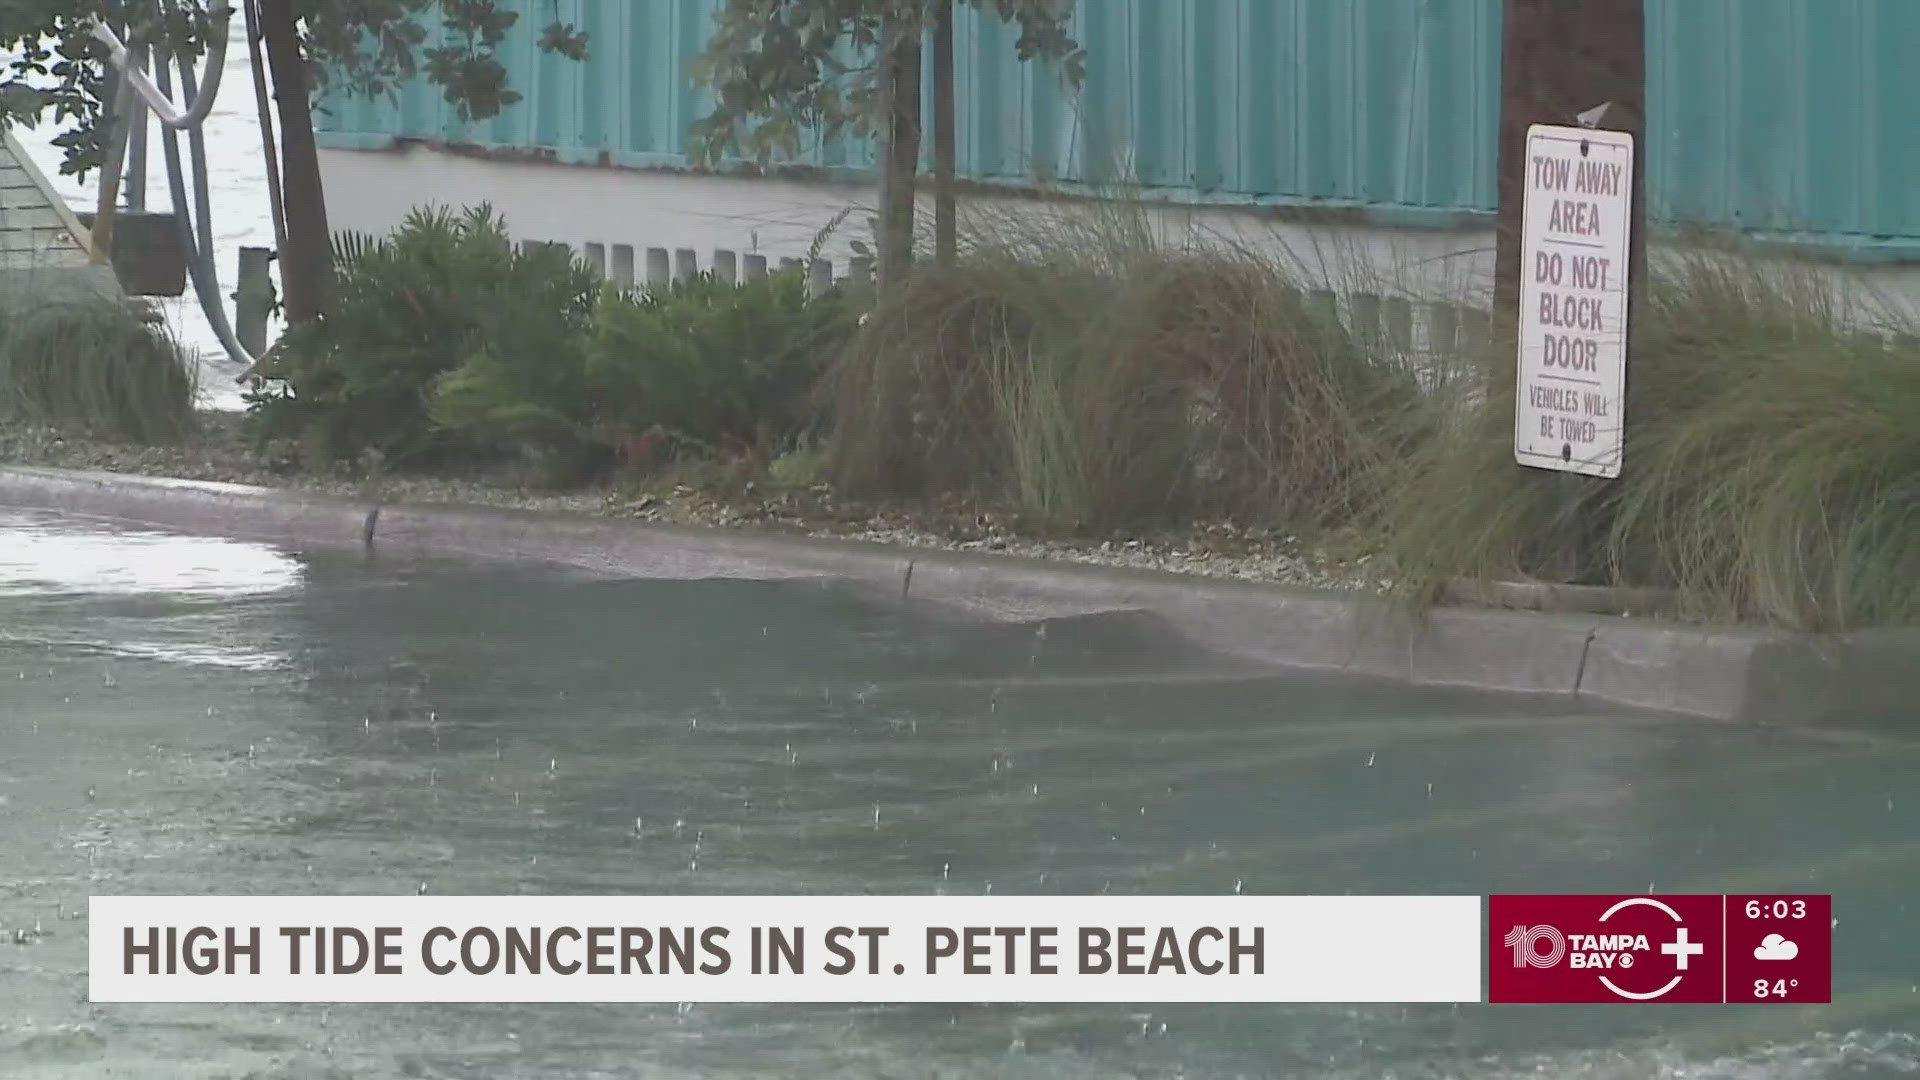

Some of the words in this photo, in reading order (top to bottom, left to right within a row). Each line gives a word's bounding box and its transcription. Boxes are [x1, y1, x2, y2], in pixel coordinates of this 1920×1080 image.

[1533, 156, 1570, 192] TOW
[1575, 160, 1622, 196] AWAY
[1549, 198, 1600, 236] AREA
[1536, 250, 1562, 285] DO
[1572, 255, 1610, 291] NOT
[1539, 292, 1603, 330] BLOCK
[1543, 334, 1598, 372] DOOR
[1529, 384, 1578, 413] VEHICLES
[1584, 392, 1607, 417] WILL
[1540, 415, 1554, 439] BE
[1560, 419, 1596, 443] TOWED
